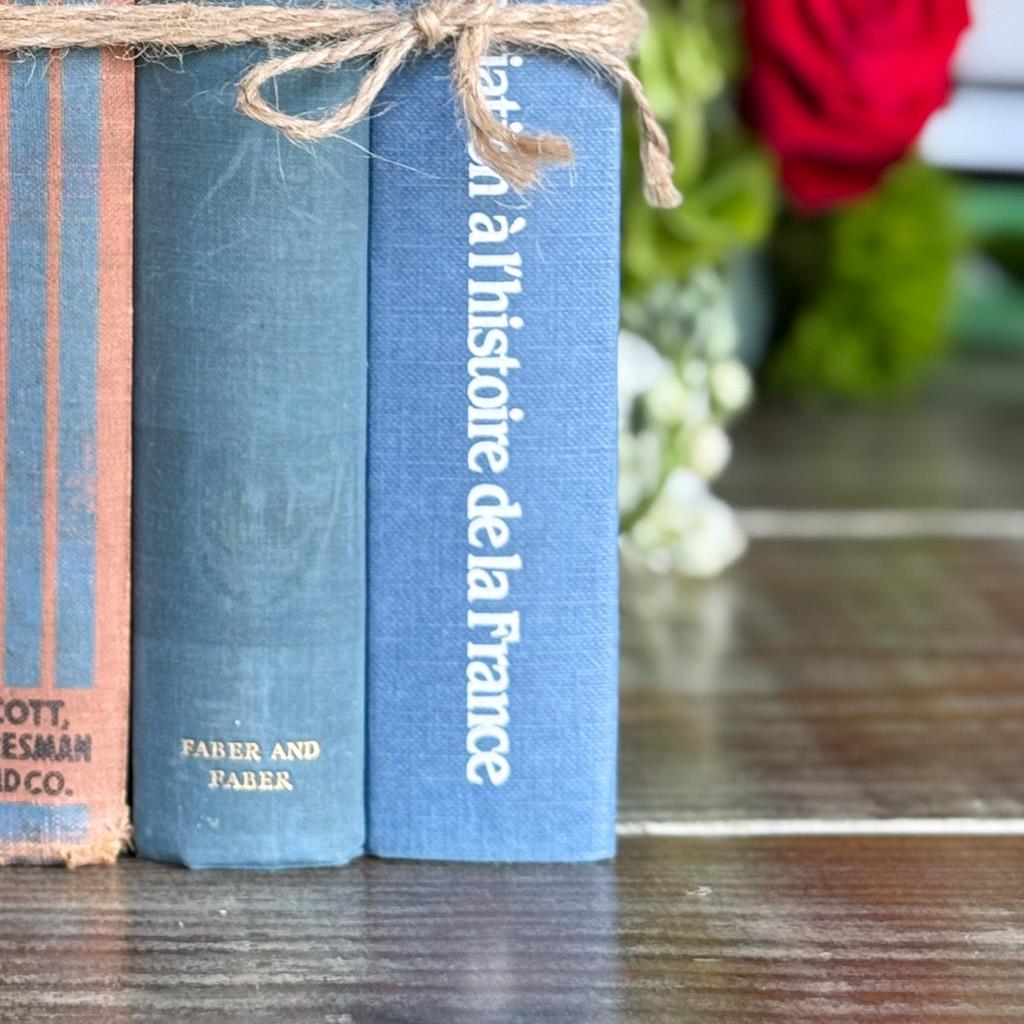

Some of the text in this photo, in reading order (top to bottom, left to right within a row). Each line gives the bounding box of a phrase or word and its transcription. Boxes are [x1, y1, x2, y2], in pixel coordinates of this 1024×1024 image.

[468, 212, 527, 246] à
[467, 251, 525, 474] l'histoire
[466, 483, 523, 549] de
[466, 553, 524, 602] la
[466, 609, 521, 786] France
[181, 739, 321, 761] FABER AND
[23, 768, 74, 797] CO.
[208, 769, 294, 792] FABER
